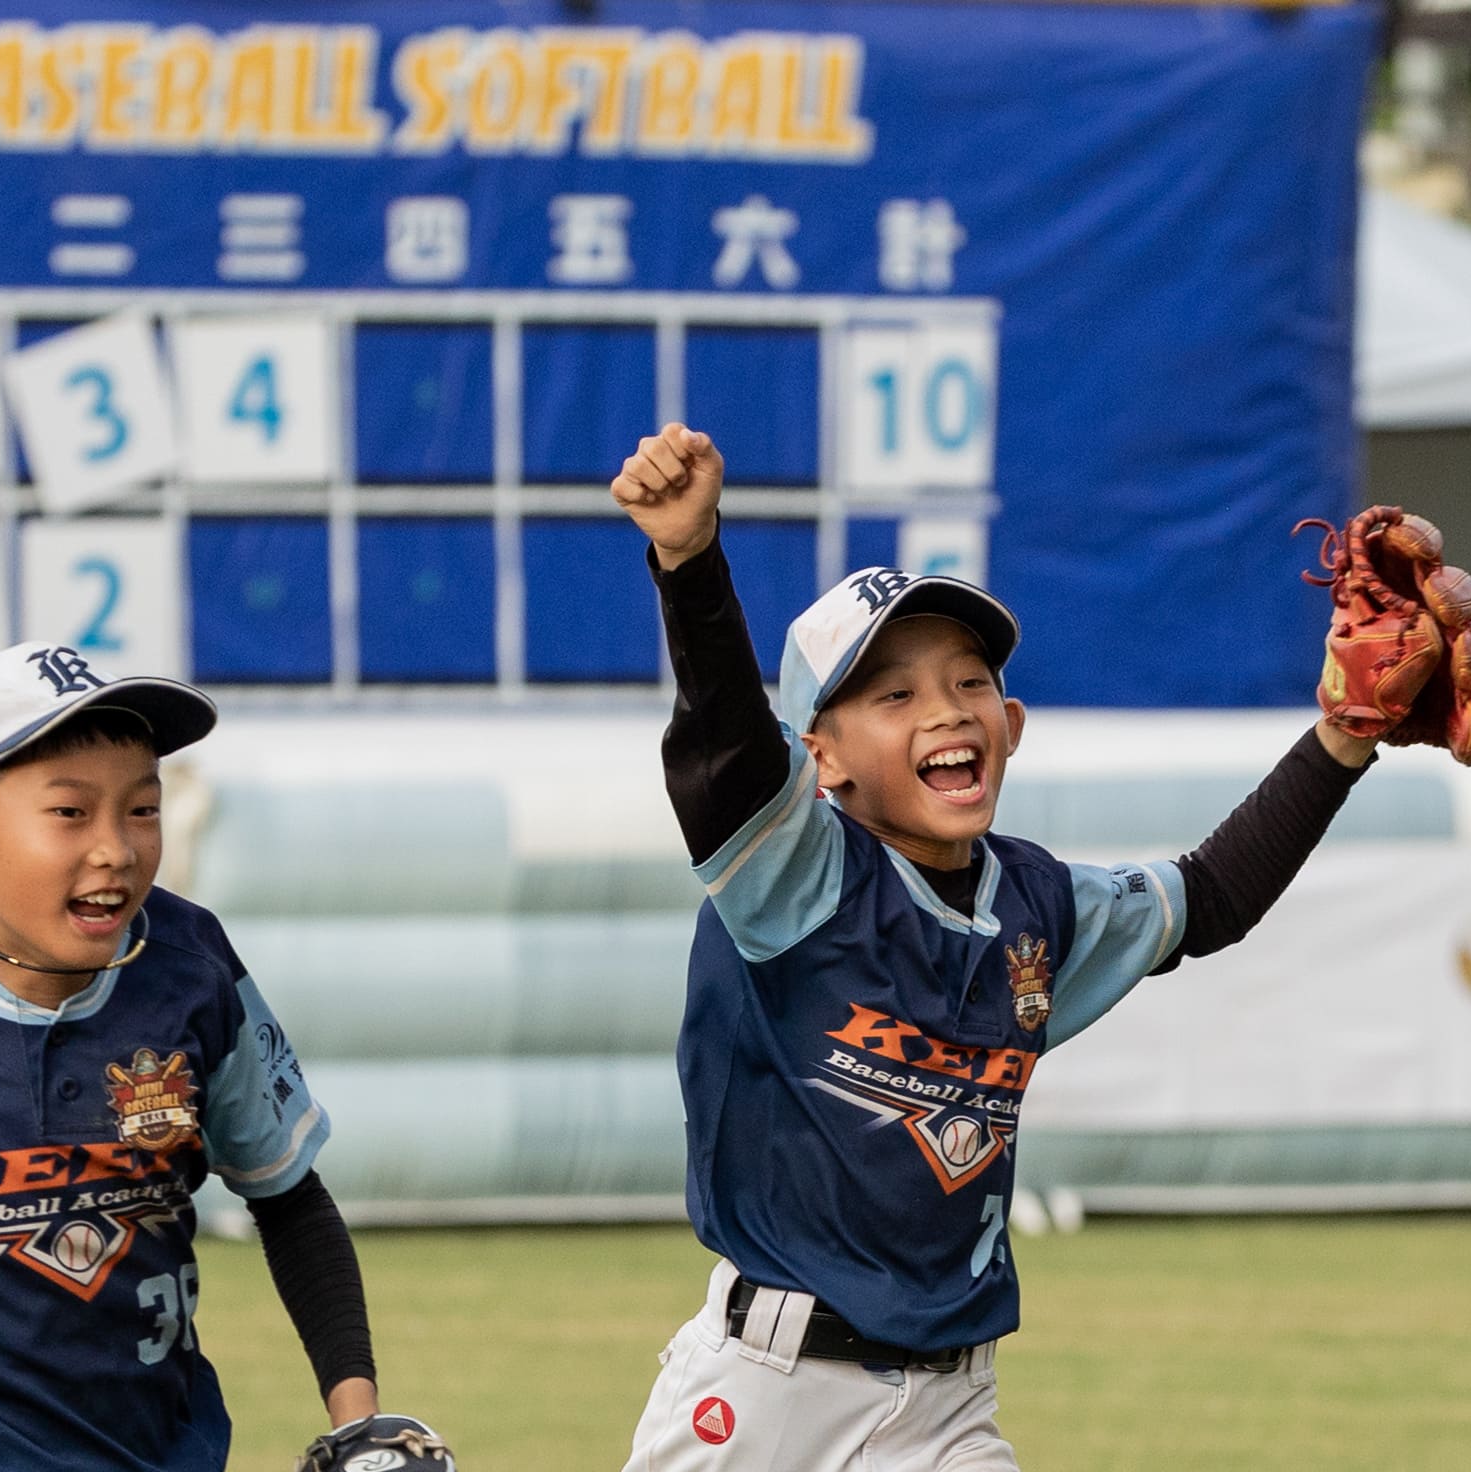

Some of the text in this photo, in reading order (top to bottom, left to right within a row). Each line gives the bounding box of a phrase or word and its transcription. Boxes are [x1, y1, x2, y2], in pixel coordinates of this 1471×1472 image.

[394, 26, 872, 160] SOFTBALL
[51, 194, 134, 276] 二
[218, 193, 304, 281] 三
[386, 196, 469, 283] 四
[550, 194, 634, 284] 五
[712, 196, 800, 288] 六
[61, 366, 131, 464] 3
[228, 350, 285, 444] 4
[865, 358, 984, 453] 10
[72, 558, 126, 652] 2
[824, 1049, 965, 1104] Baseball
